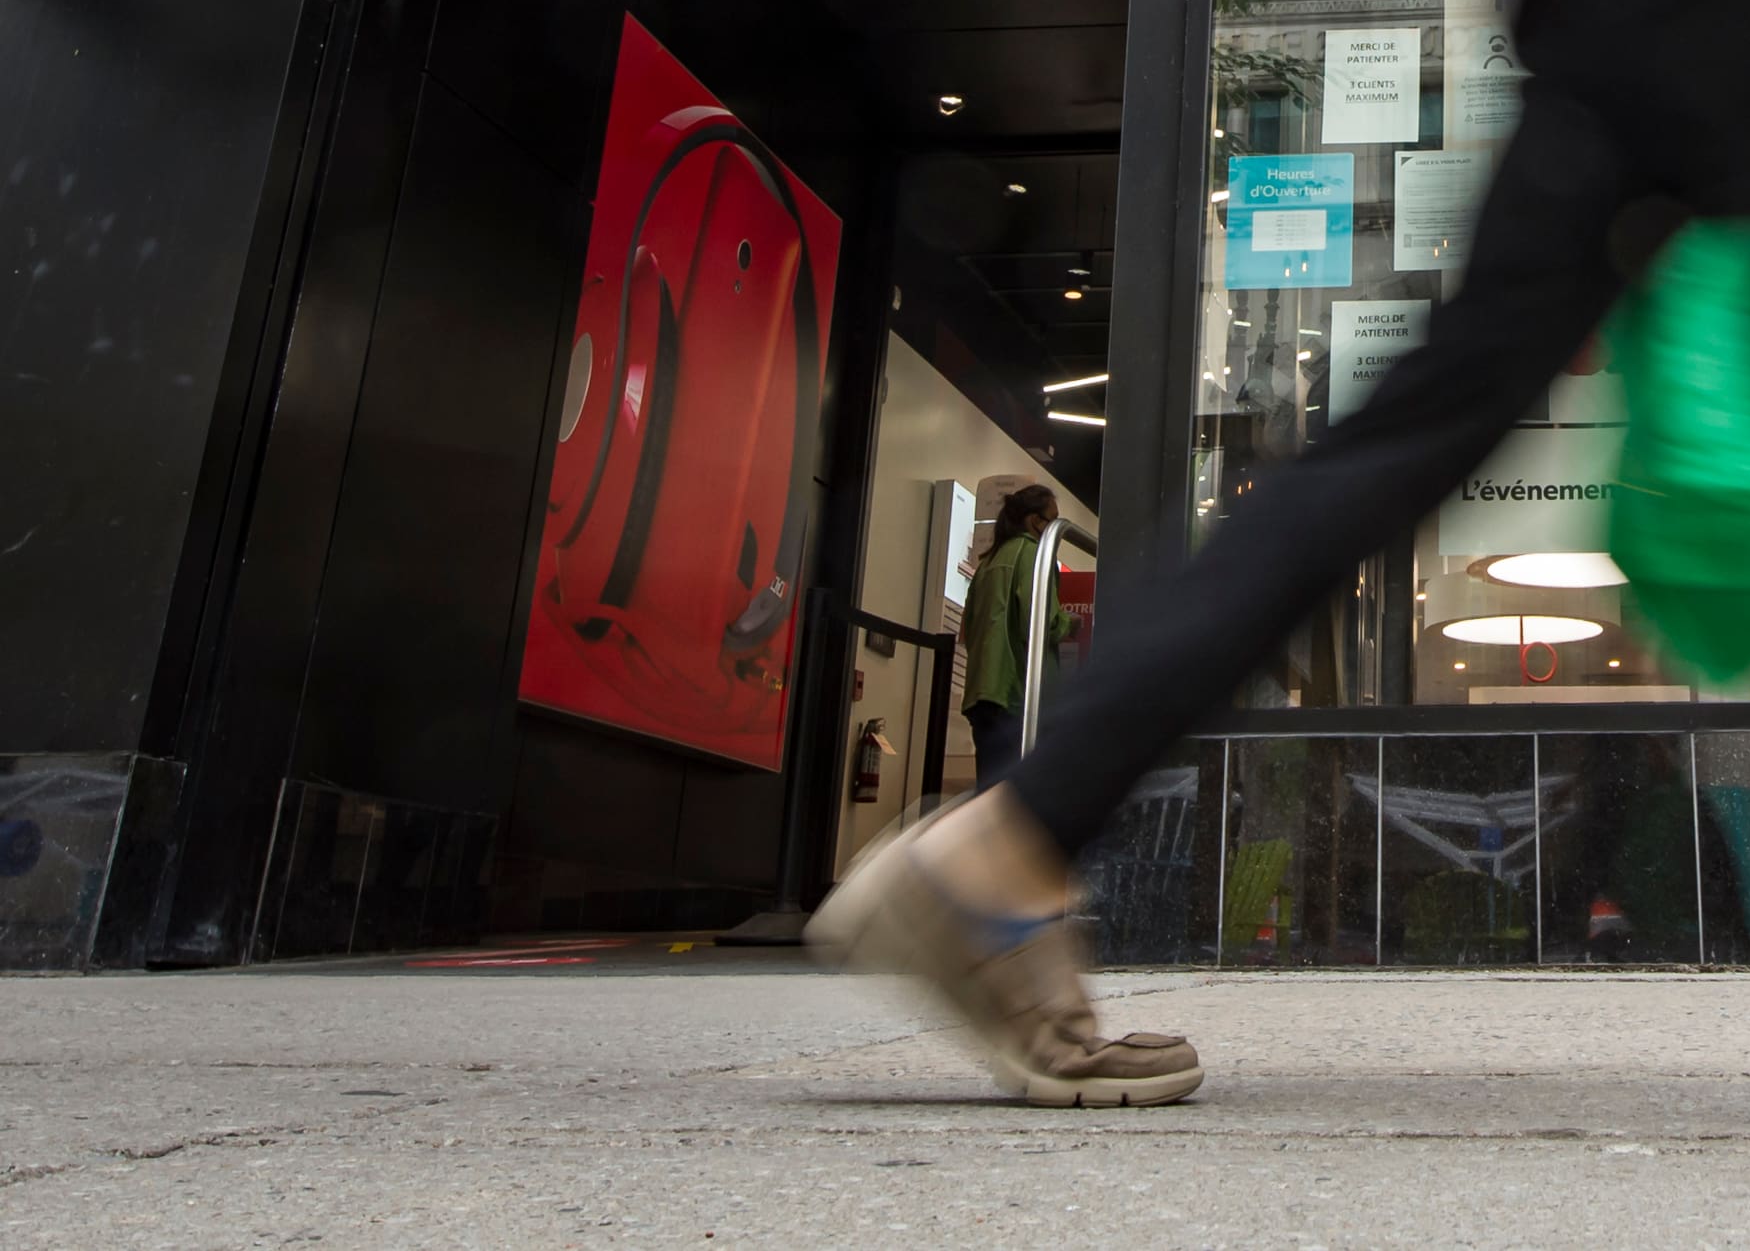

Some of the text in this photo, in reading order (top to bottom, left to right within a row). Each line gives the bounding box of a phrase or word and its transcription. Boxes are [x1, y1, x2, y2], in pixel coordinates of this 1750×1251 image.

[1350, 42, 1396, 51] MERCI DE
[1347, 55, 1399, 64] PATIENTER
[1357, 80, 1396, 89] CLIENTS
[1345, 93, 1399, 102] MAXIMUM
[1267, 169, 1315, 180] Heures
[1250, 185, 1331, 198] d'Ouverture
[1358, 314, 1406, 324] MERCI DE
[1354, 328, 1409, 338] PATIENTER
[1356, 355, 1401, 365] 3 CLIENT
[1462, 479, 1614, 501] L'événemen
